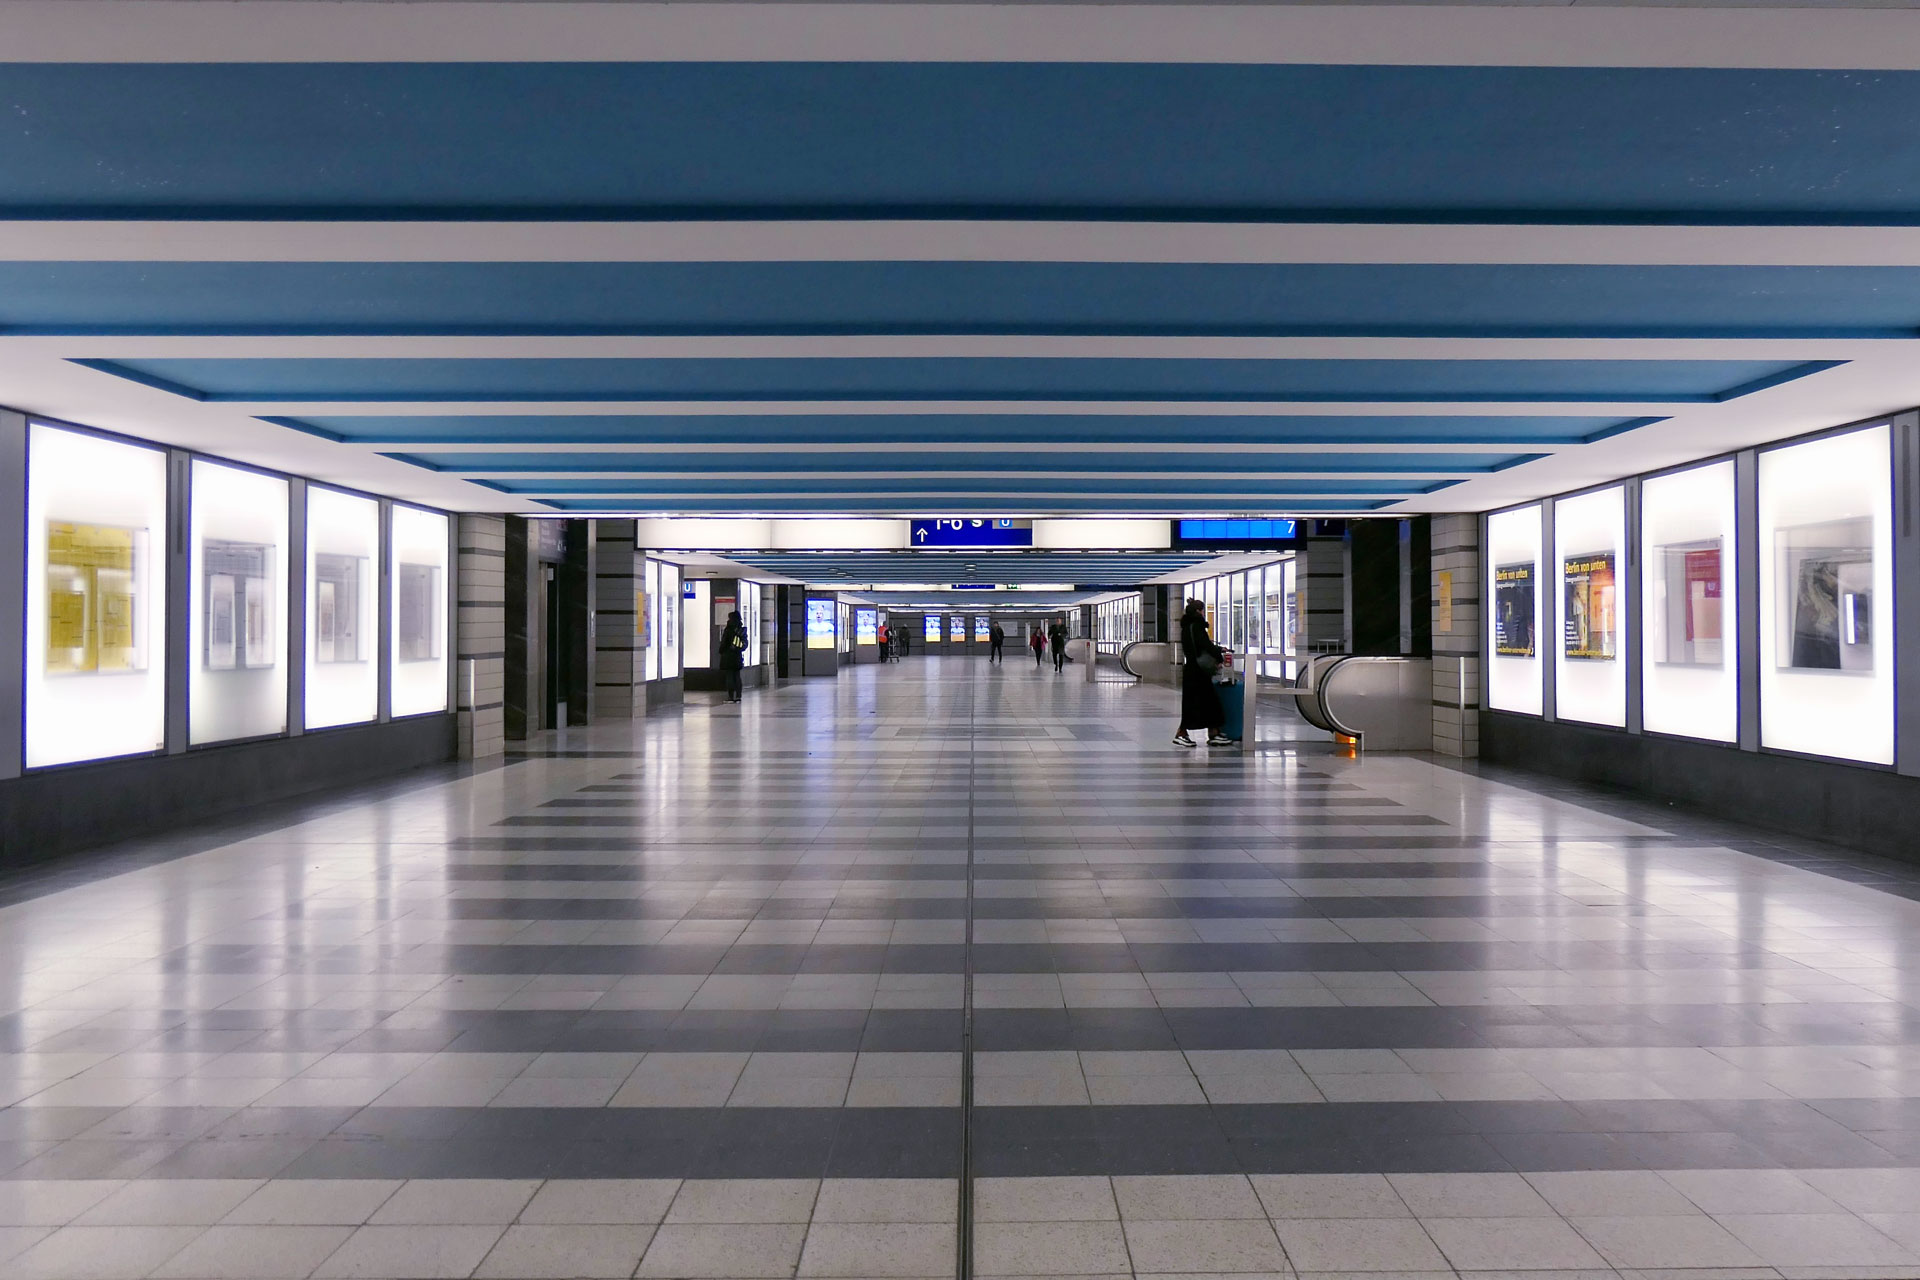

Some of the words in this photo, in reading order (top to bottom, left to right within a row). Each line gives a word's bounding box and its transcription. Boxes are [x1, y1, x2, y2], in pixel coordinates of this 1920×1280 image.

[1287, 520, 1295, 533] 7
[1565, 562, 1580, 574] Berlin
[1580, 562, 1590, 572] von
[1590, 560, 1606, 571] unten
[684, 583, 691, 592] U
